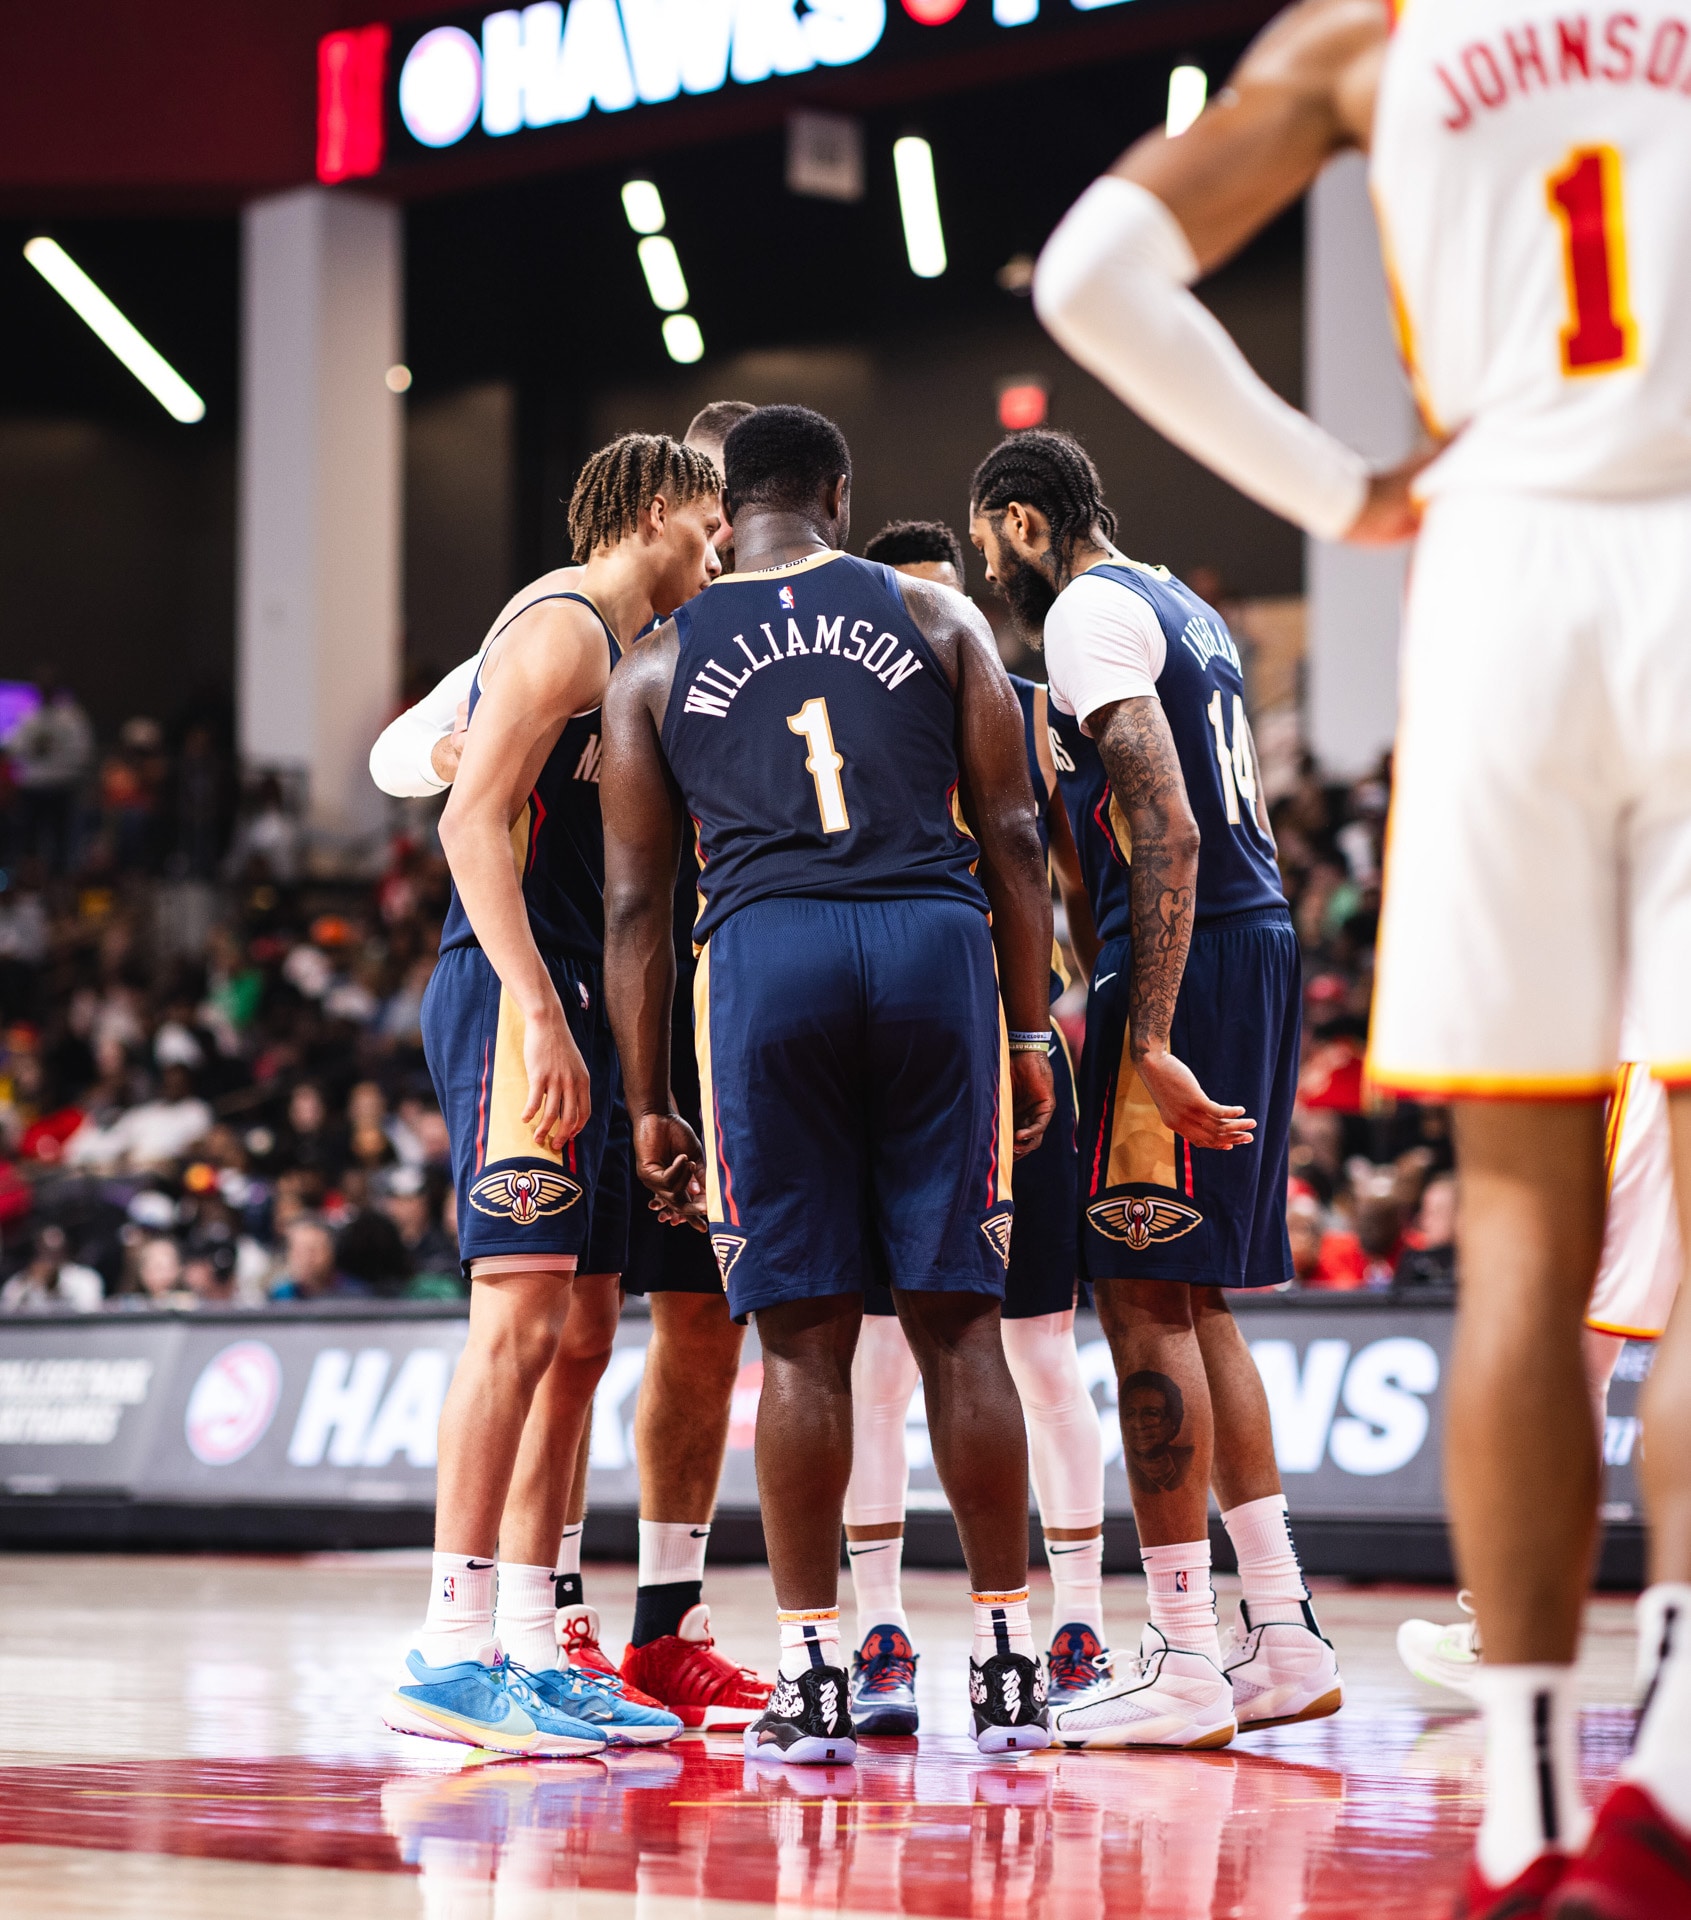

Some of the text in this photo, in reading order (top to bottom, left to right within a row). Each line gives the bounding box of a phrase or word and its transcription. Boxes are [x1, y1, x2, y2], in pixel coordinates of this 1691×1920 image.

[1433, 12, 1691, 135] JOHNSO
[1546, 143, 1641, 378] 1
[683, 614, 924, 718] WILLIAMSON
[786, 696, 851, 834] 1
[1207, 689, 1258, 825] 14
